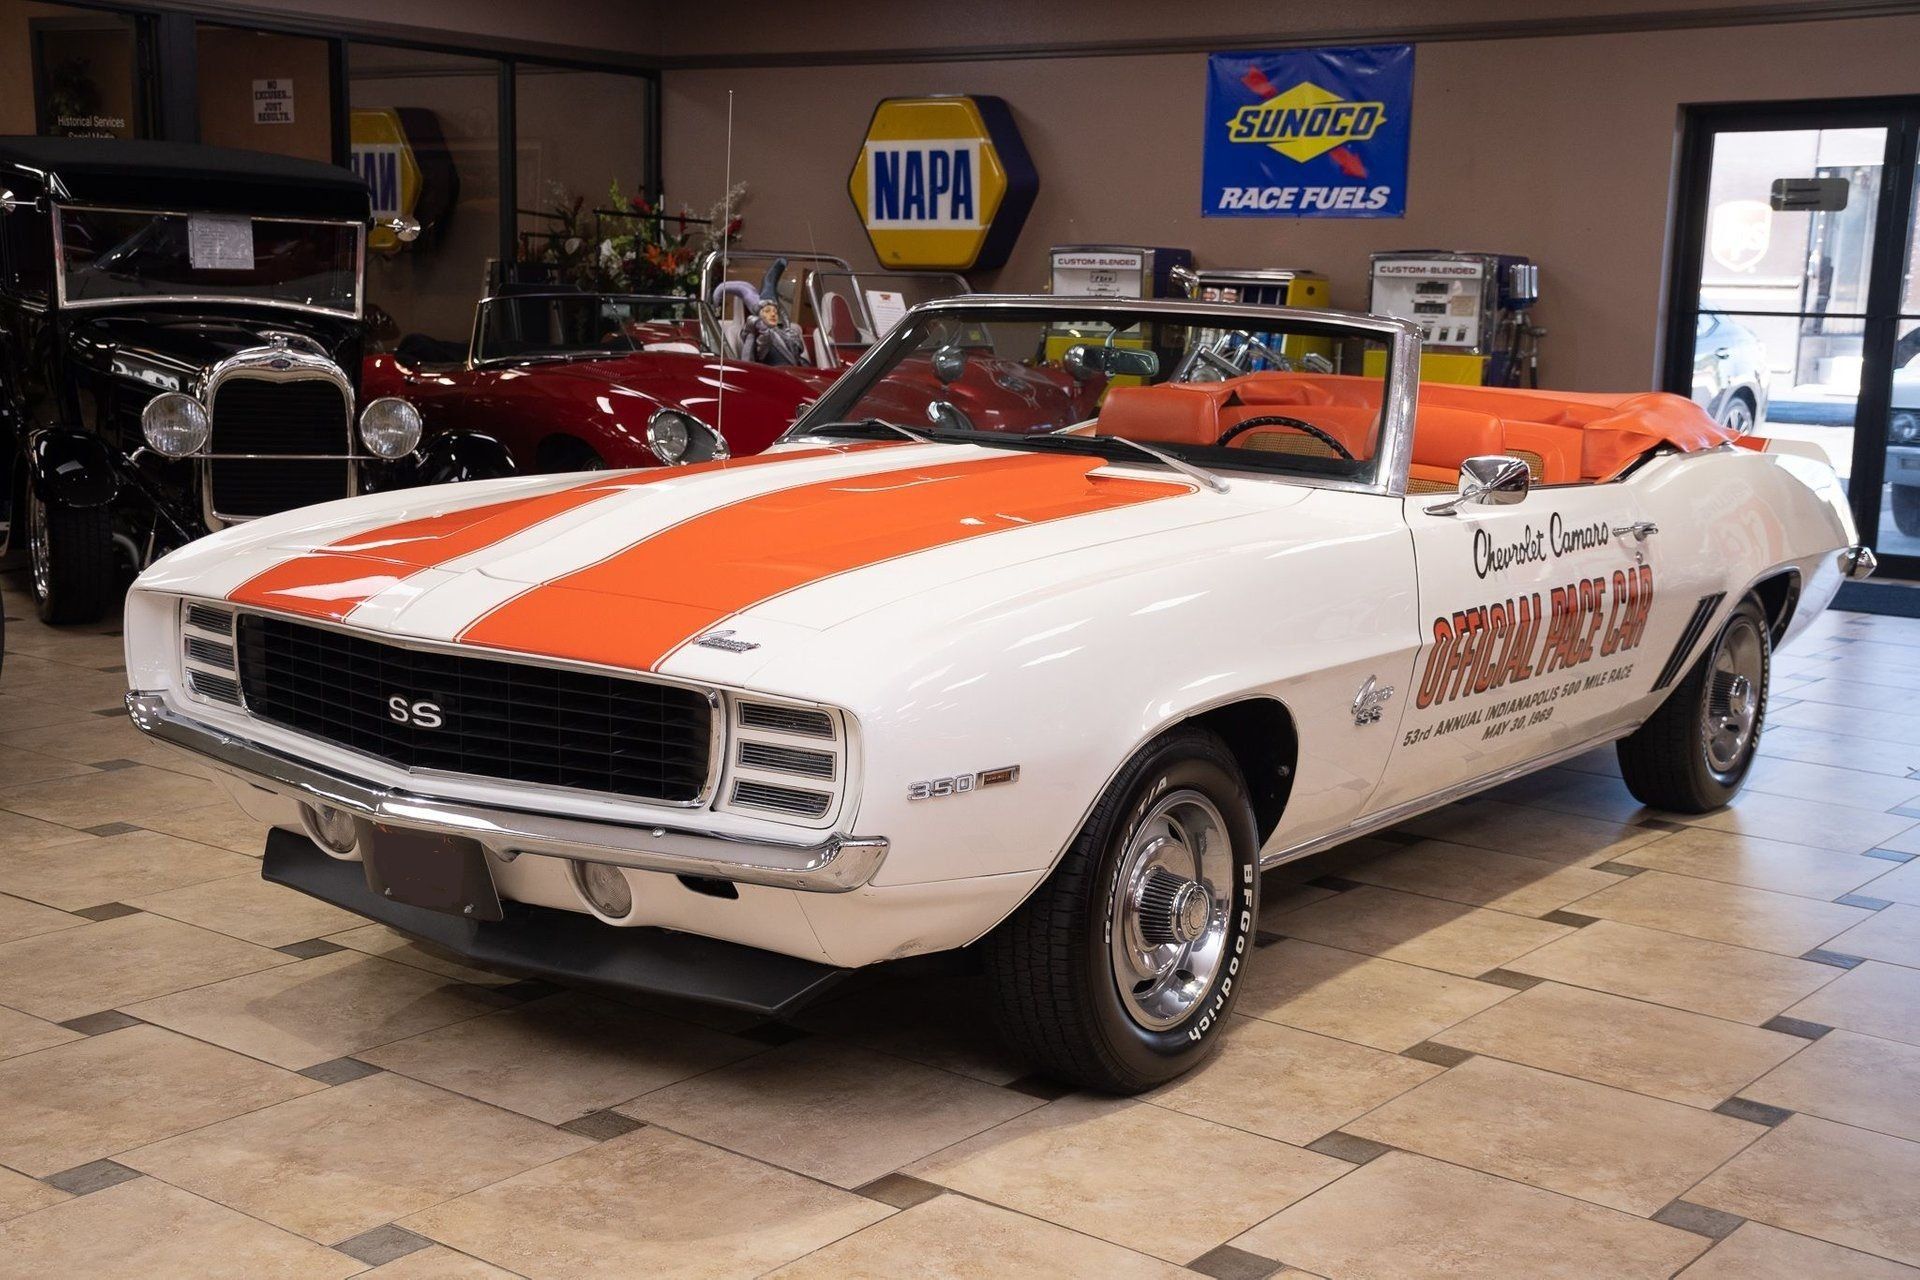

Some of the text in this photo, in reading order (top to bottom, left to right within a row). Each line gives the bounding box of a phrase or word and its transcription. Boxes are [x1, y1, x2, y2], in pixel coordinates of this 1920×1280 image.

[267, 80, 278, 90] NO
[57, 115, 125, 128] Historical Services
[1234, 106, 1379, 138] SUNOCO
[875, 149, 973, 220] NAPA
[1218, 186, 1391, 210] RACE FUELS
[1473, 512, 1609, 579] Chevrolet Camaro
[1416, 564, 1653, 709] OFFICIAL PACE CAR
[389, 696, 442, 728] SS
[1403, 664, 1634, 747] 53rd ANNUAL INDIANAPOLIS 500 MILE RACE
[1481, 719, 1509, 741] MAY
[907, 773, 975, 801] 350
[1188, 864, 1252, 1042] BFGoodrich
